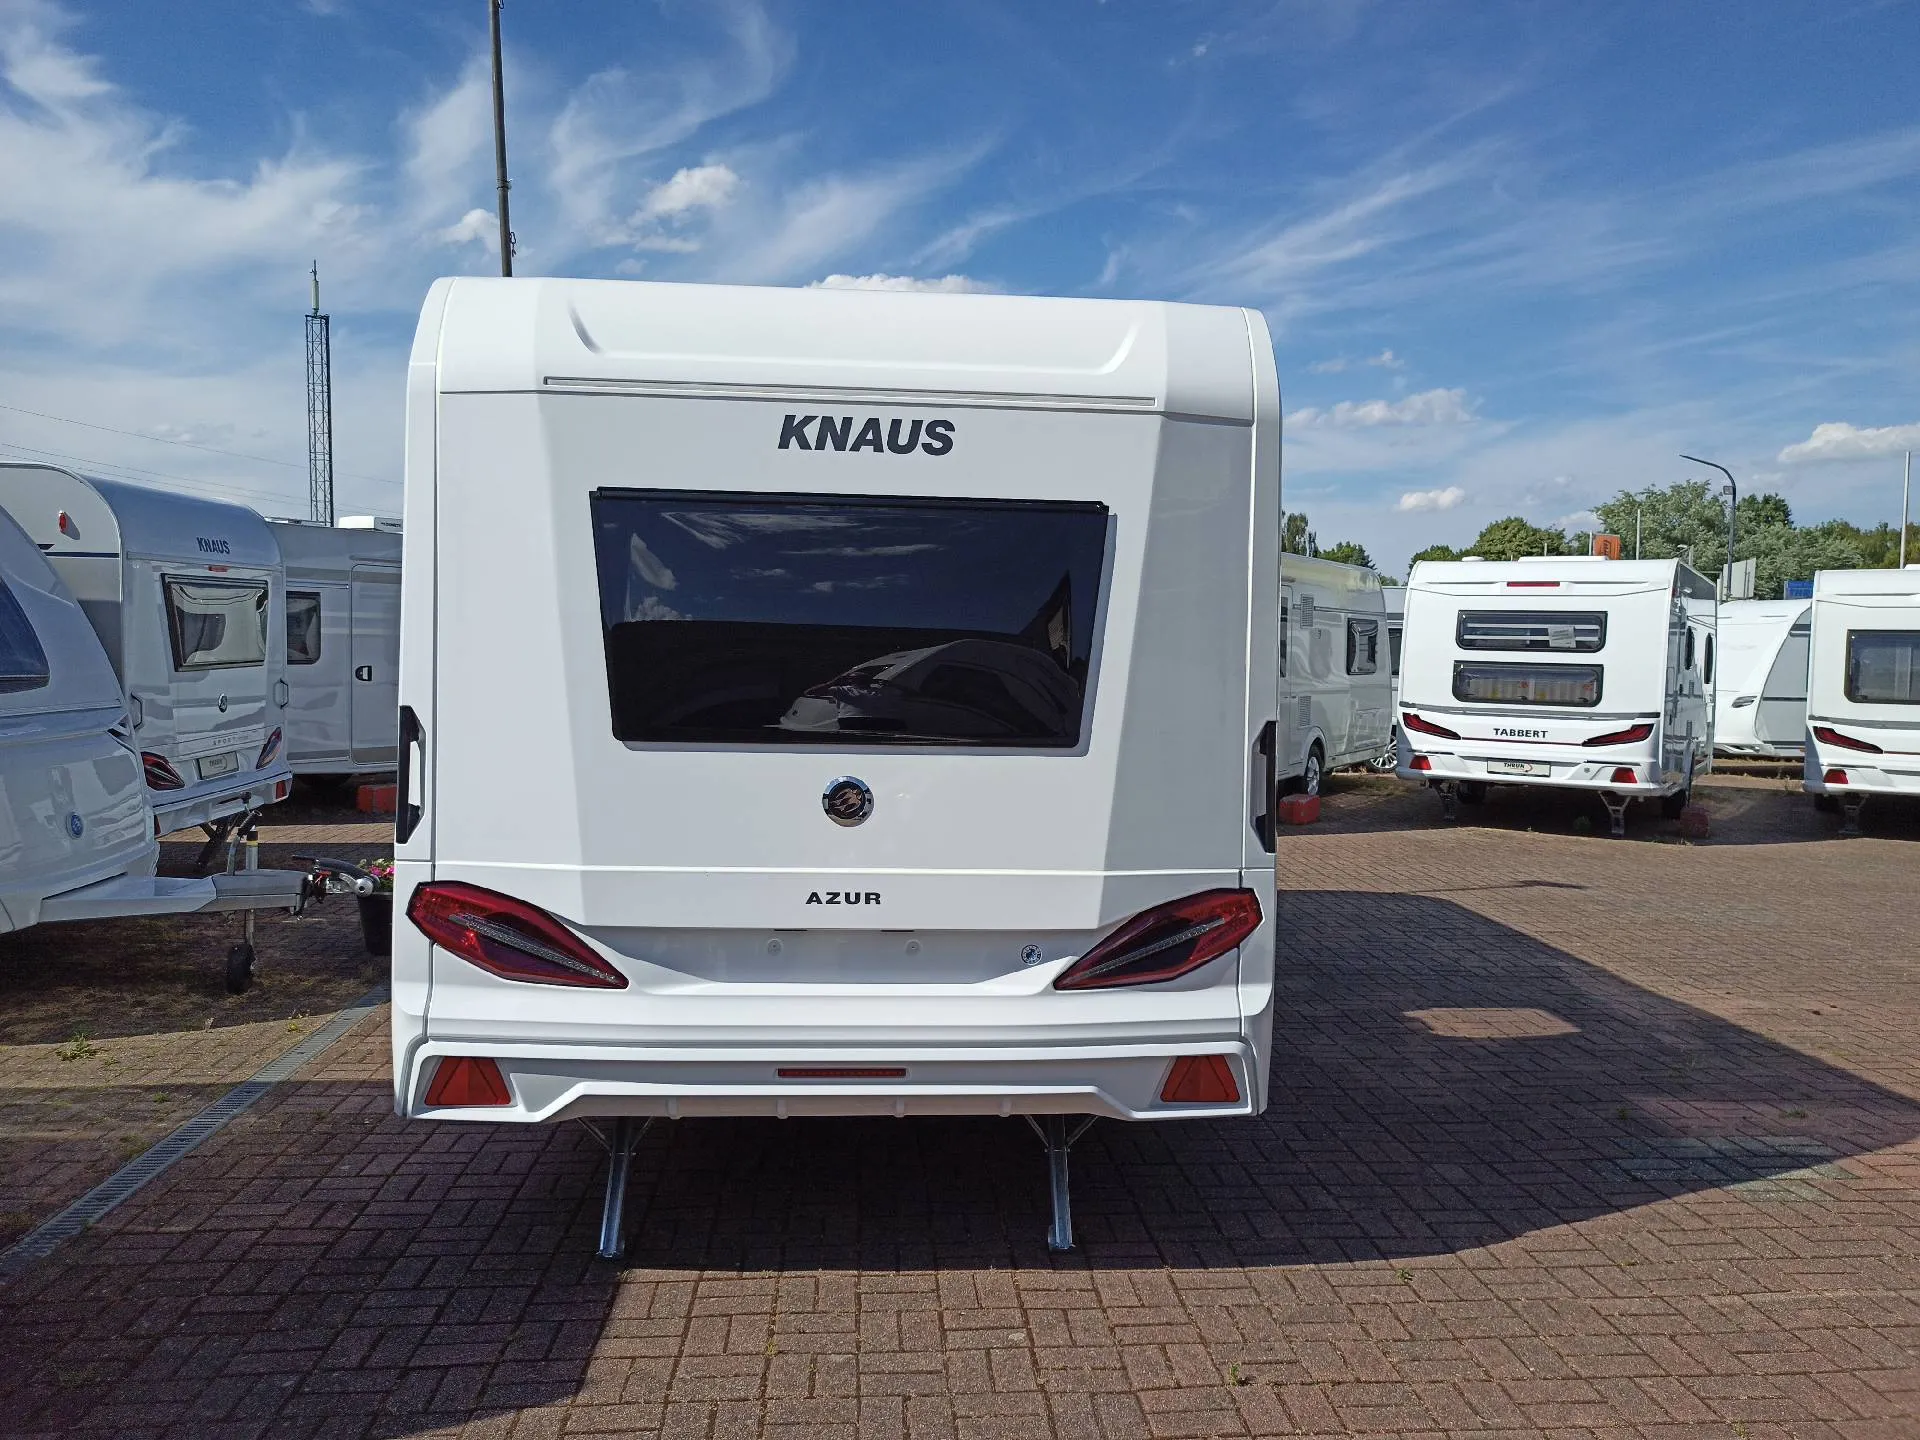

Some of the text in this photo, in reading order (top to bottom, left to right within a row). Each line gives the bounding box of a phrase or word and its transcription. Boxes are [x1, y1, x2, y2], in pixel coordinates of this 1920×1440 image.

[777, 414, 956, 456] KNAUS
[196, 537, 230, 554] KNAUS
[1493, 728, 1548, 738] TABBERT
[805, 891, 881, 905] AZUR
